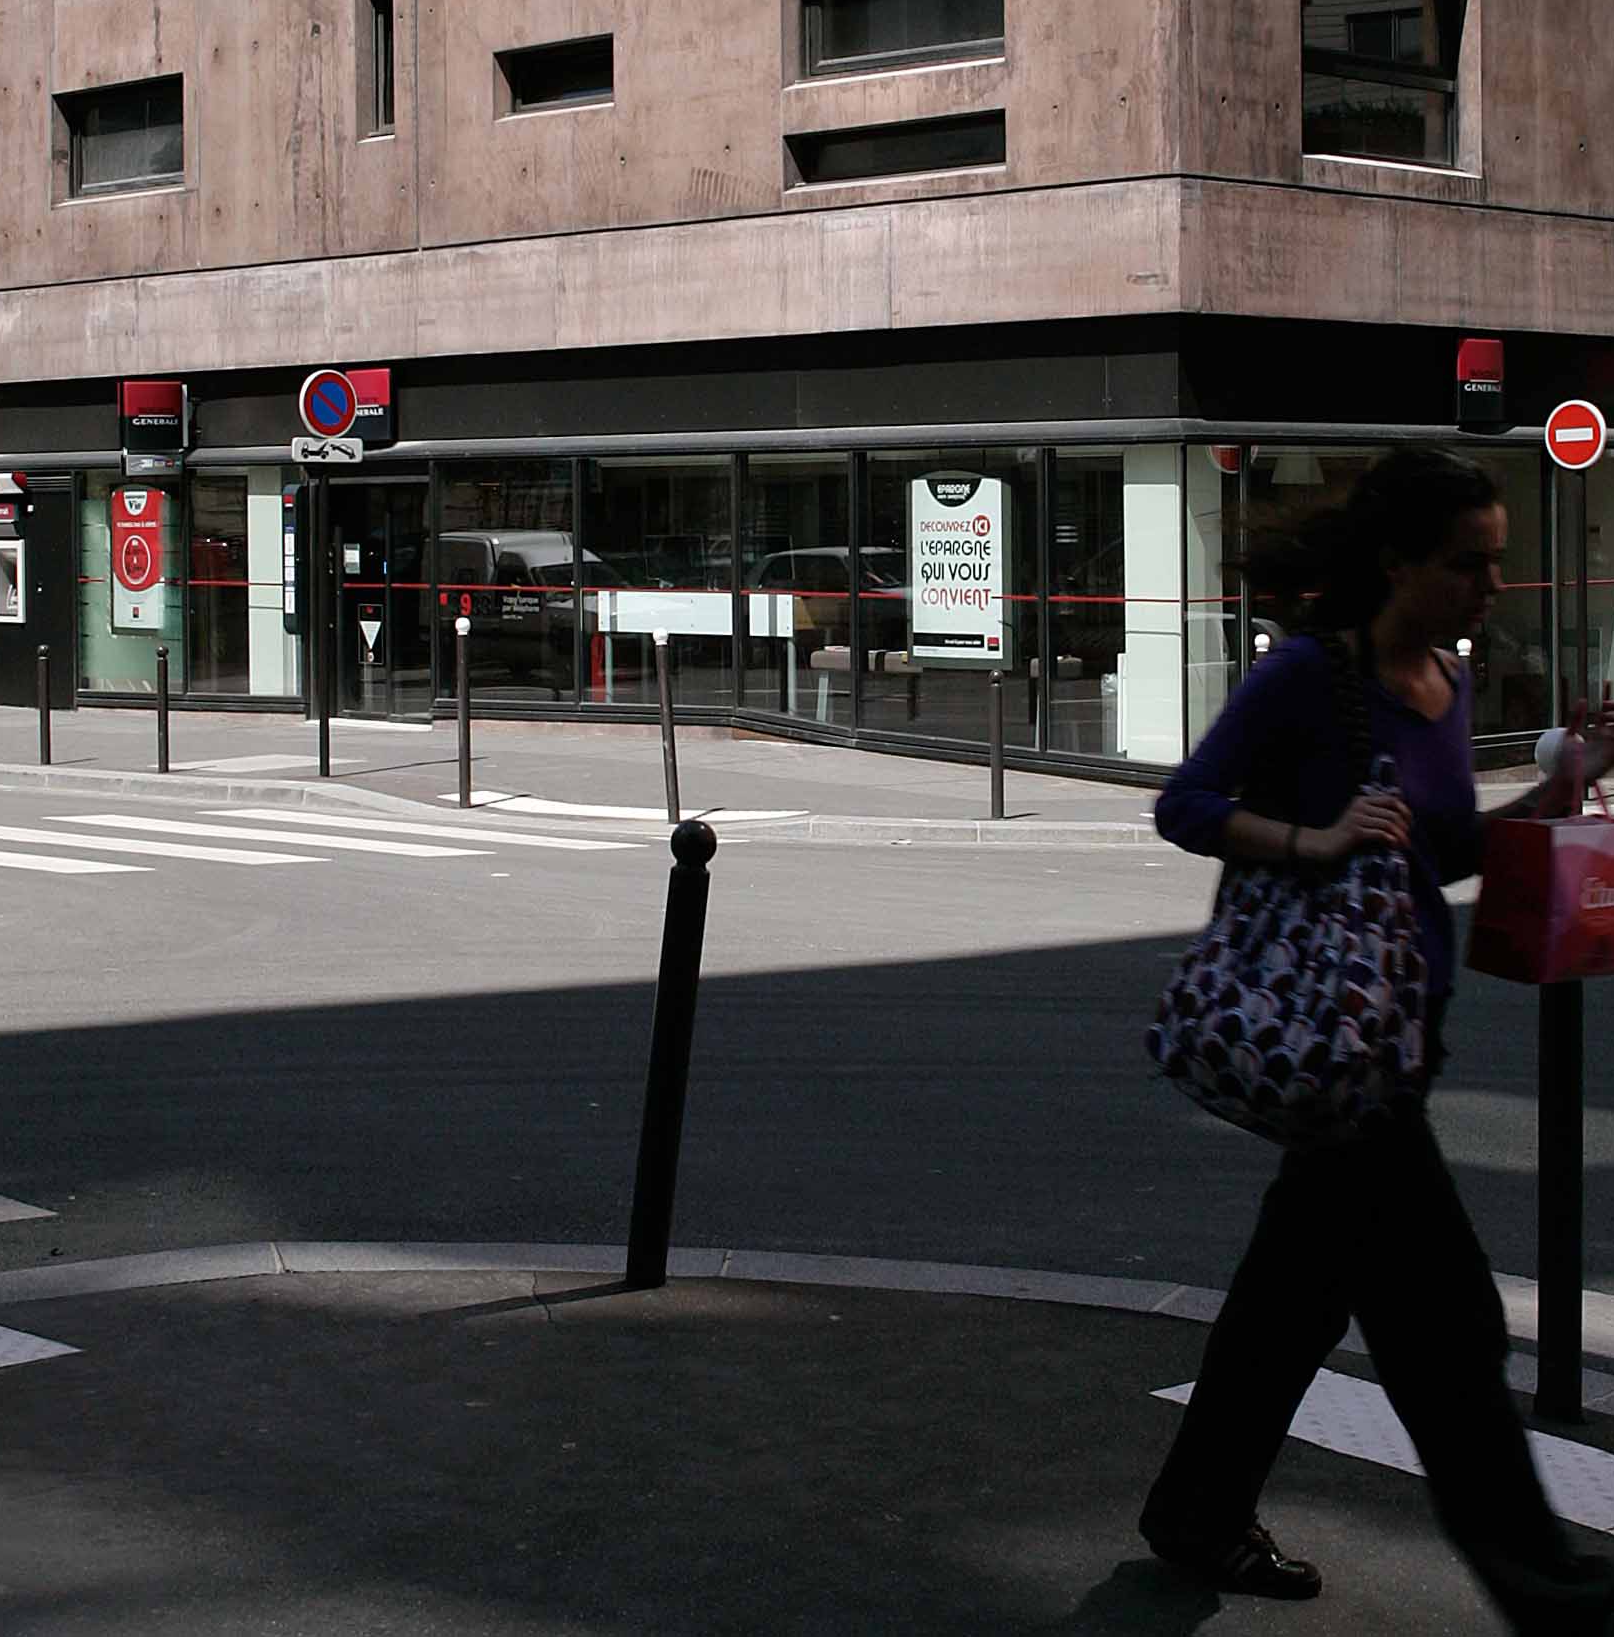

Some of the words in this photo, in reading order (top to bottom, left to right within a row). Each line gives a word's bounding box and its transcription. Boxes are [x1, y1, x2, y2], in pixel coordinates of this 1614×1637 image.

[920, 520, 971, 533] DECOUVREZ
[920, 540, 992, 560] L'EPARGNE
[921, 562, 945, 583] QUI
[948, 563, 991, 582] VOUS
[921, 587, 992, 610] CONVIENT
